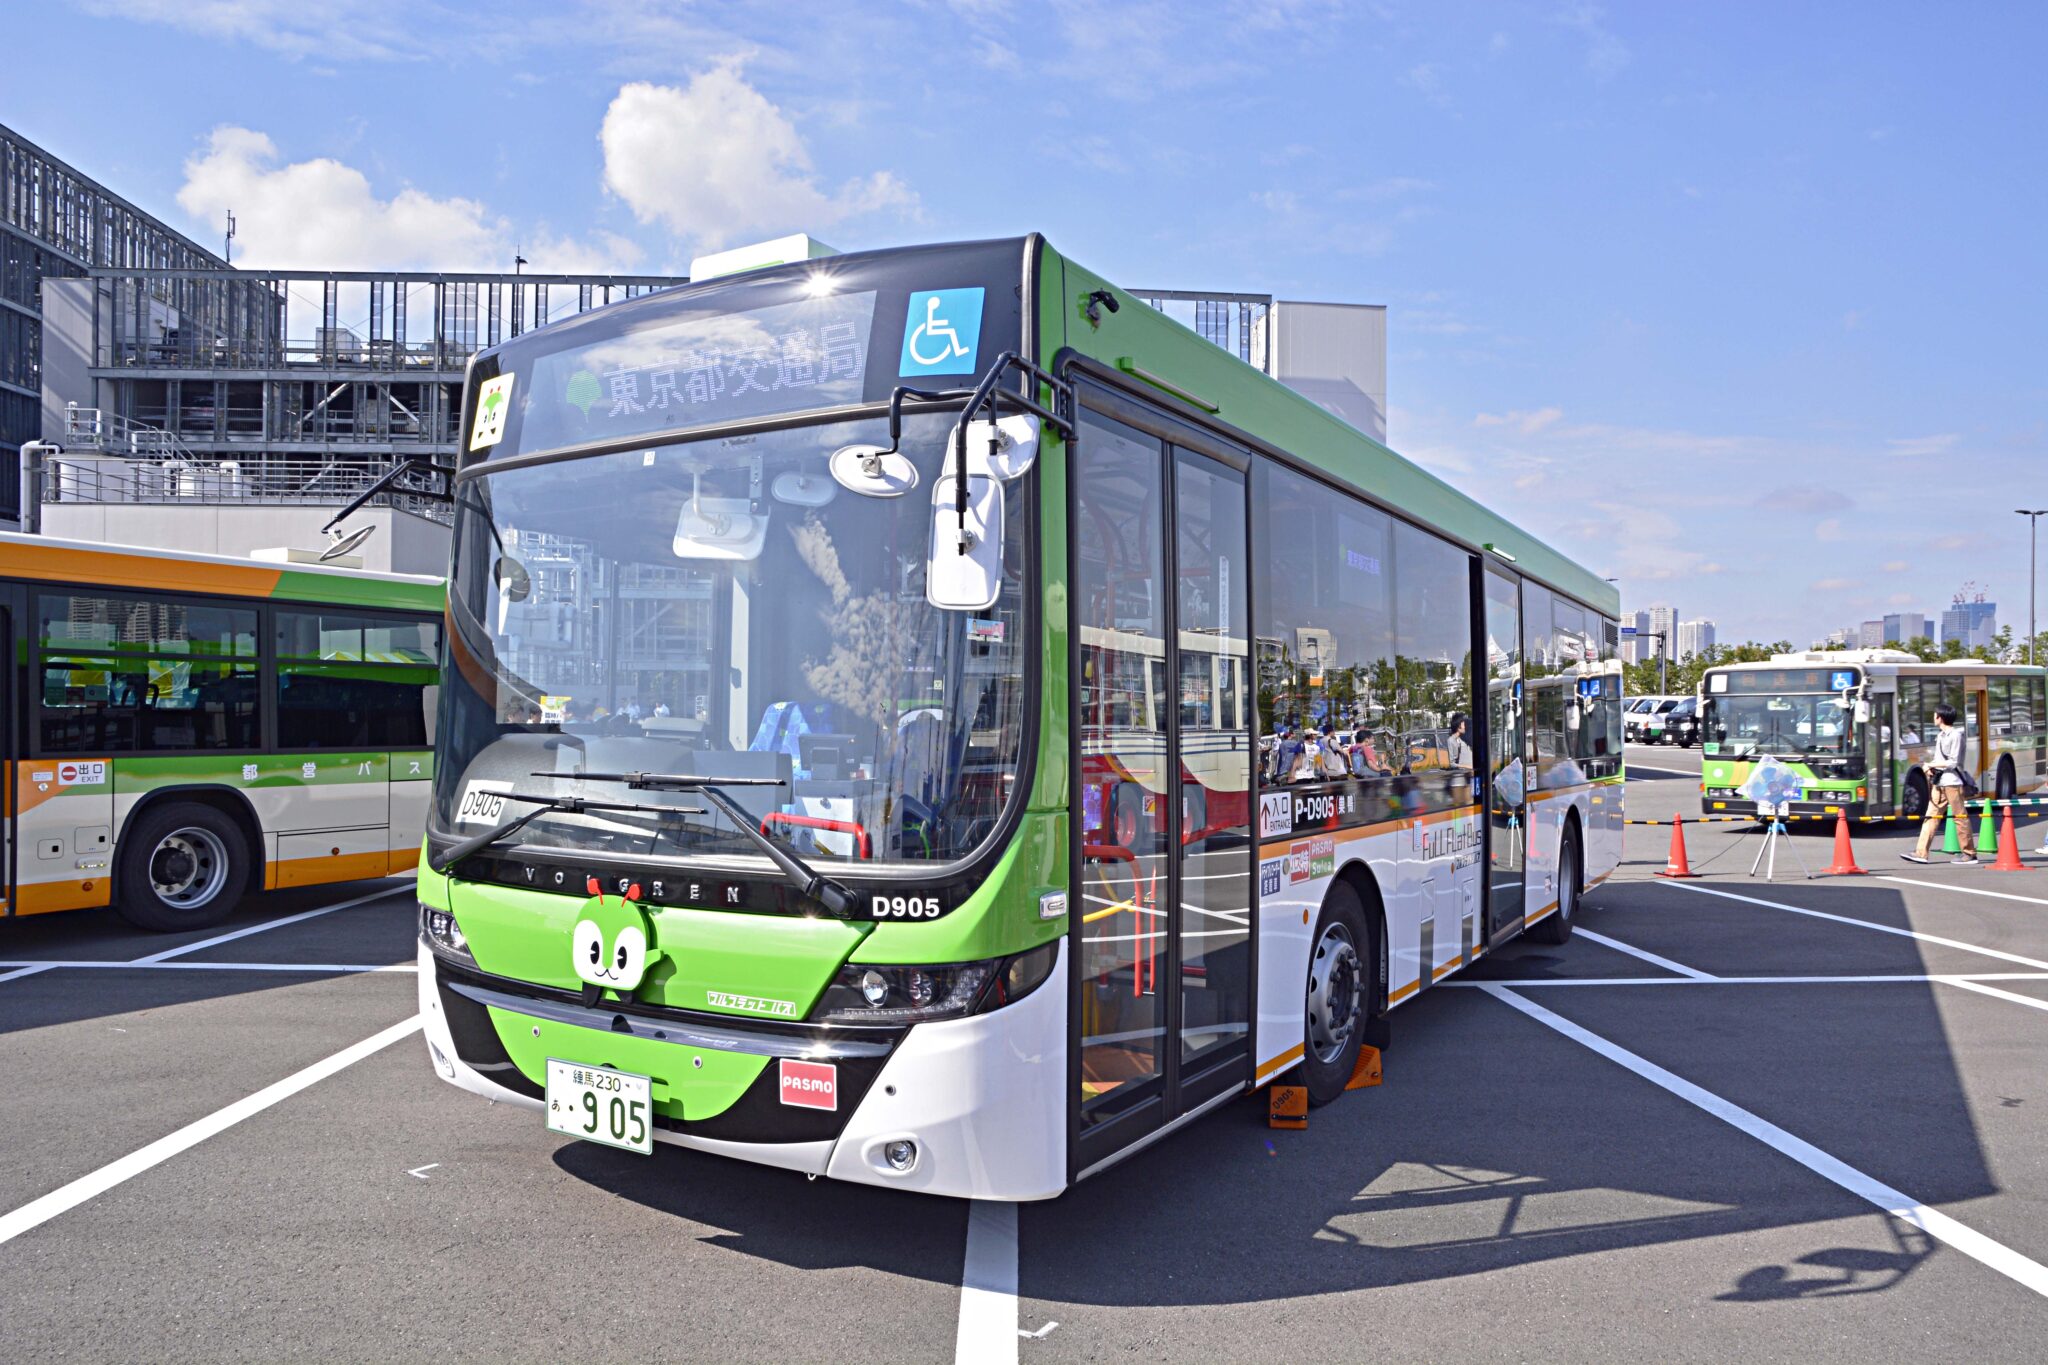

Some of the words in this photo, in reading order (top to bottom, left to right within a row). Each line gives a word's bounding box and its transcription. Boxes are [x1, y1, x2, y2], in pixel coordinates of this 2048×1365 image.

[603, 321, 863, 418] 東京都交通局
[78, 763, 103, 775] 出口
[81, 775, 99, 783] EXIT
[462, 791, 502, 818] D905
[1272, 796, 1289, 817] 入口
[1269, 817, 1291, 832] ENTRANCE
[525, 867, 740, 903] VOGREN
[872, 896, 940, 918] D905
[783, 1075, 833, 1094] PASMO
